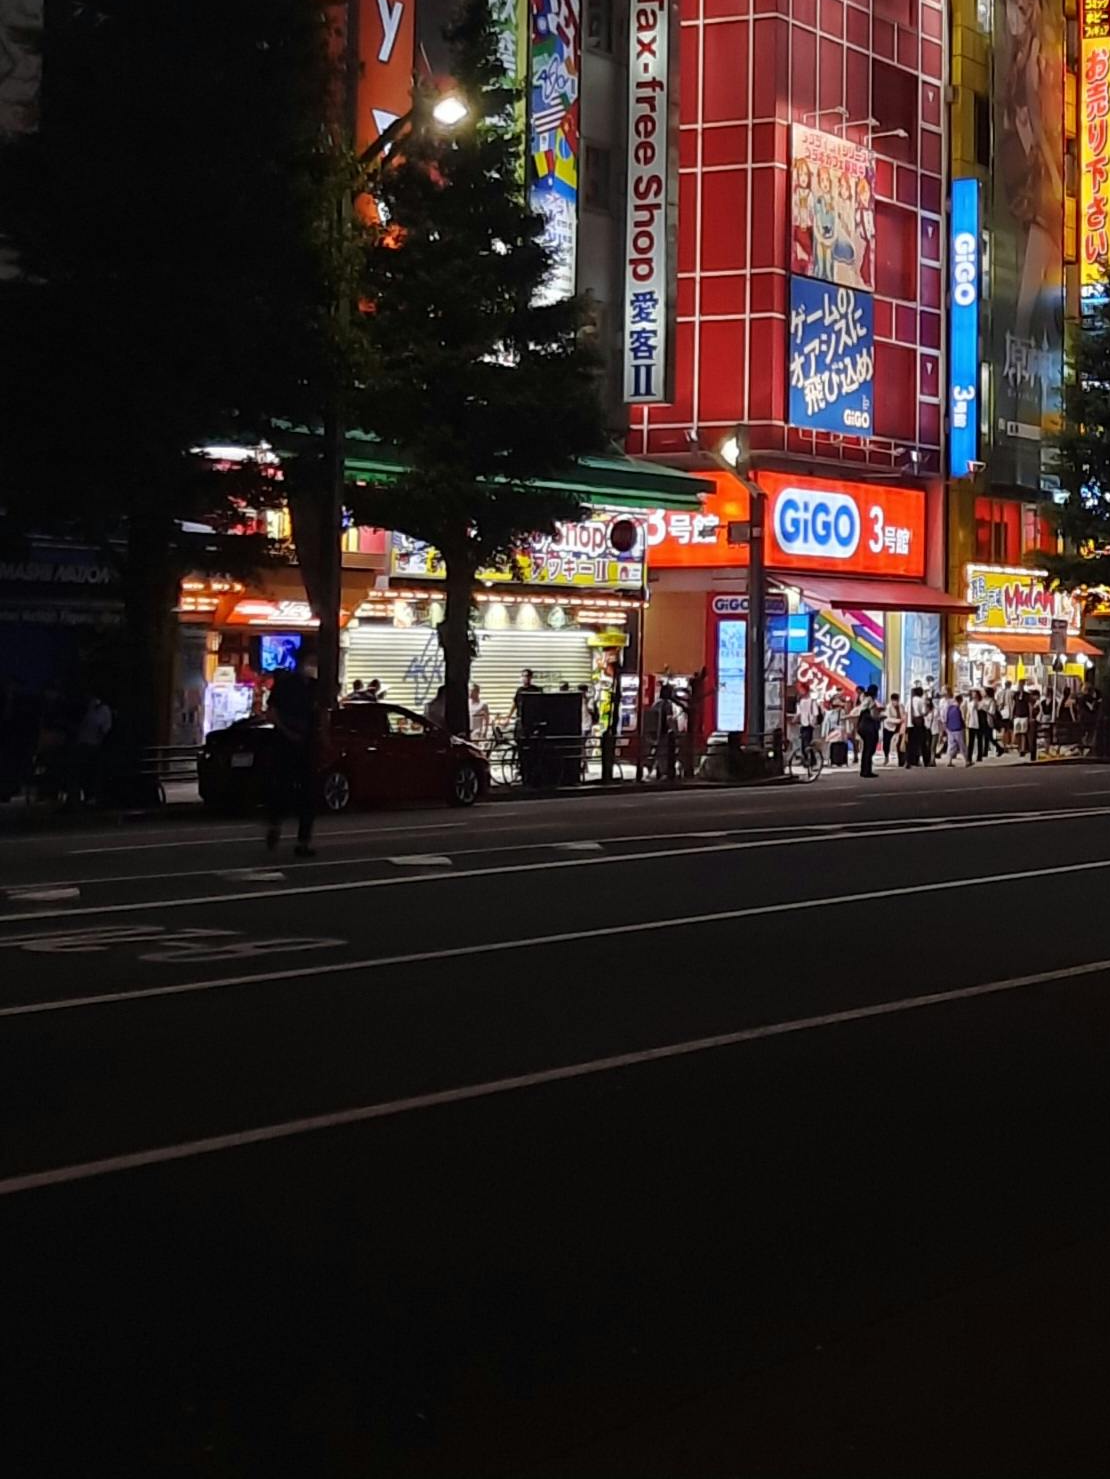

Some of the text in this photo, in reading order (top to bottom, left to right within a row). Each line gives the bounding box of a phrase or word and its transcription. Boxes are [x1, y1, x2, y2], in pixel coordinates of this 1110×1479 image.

[1084, 49, 1110, 265] お売り下さい
[628, 173, 663, 283] Shop
[953, 231, 976, 307] GiGO
[790, 288, 855, 344] ゲームの
[790, 307, 868, 389] オアシスに
[804, 345, 875, 417] 飛び込め
[843, 408, 870, 428] GiGO
[779, 498, 910, 556] GiGO 3号館
